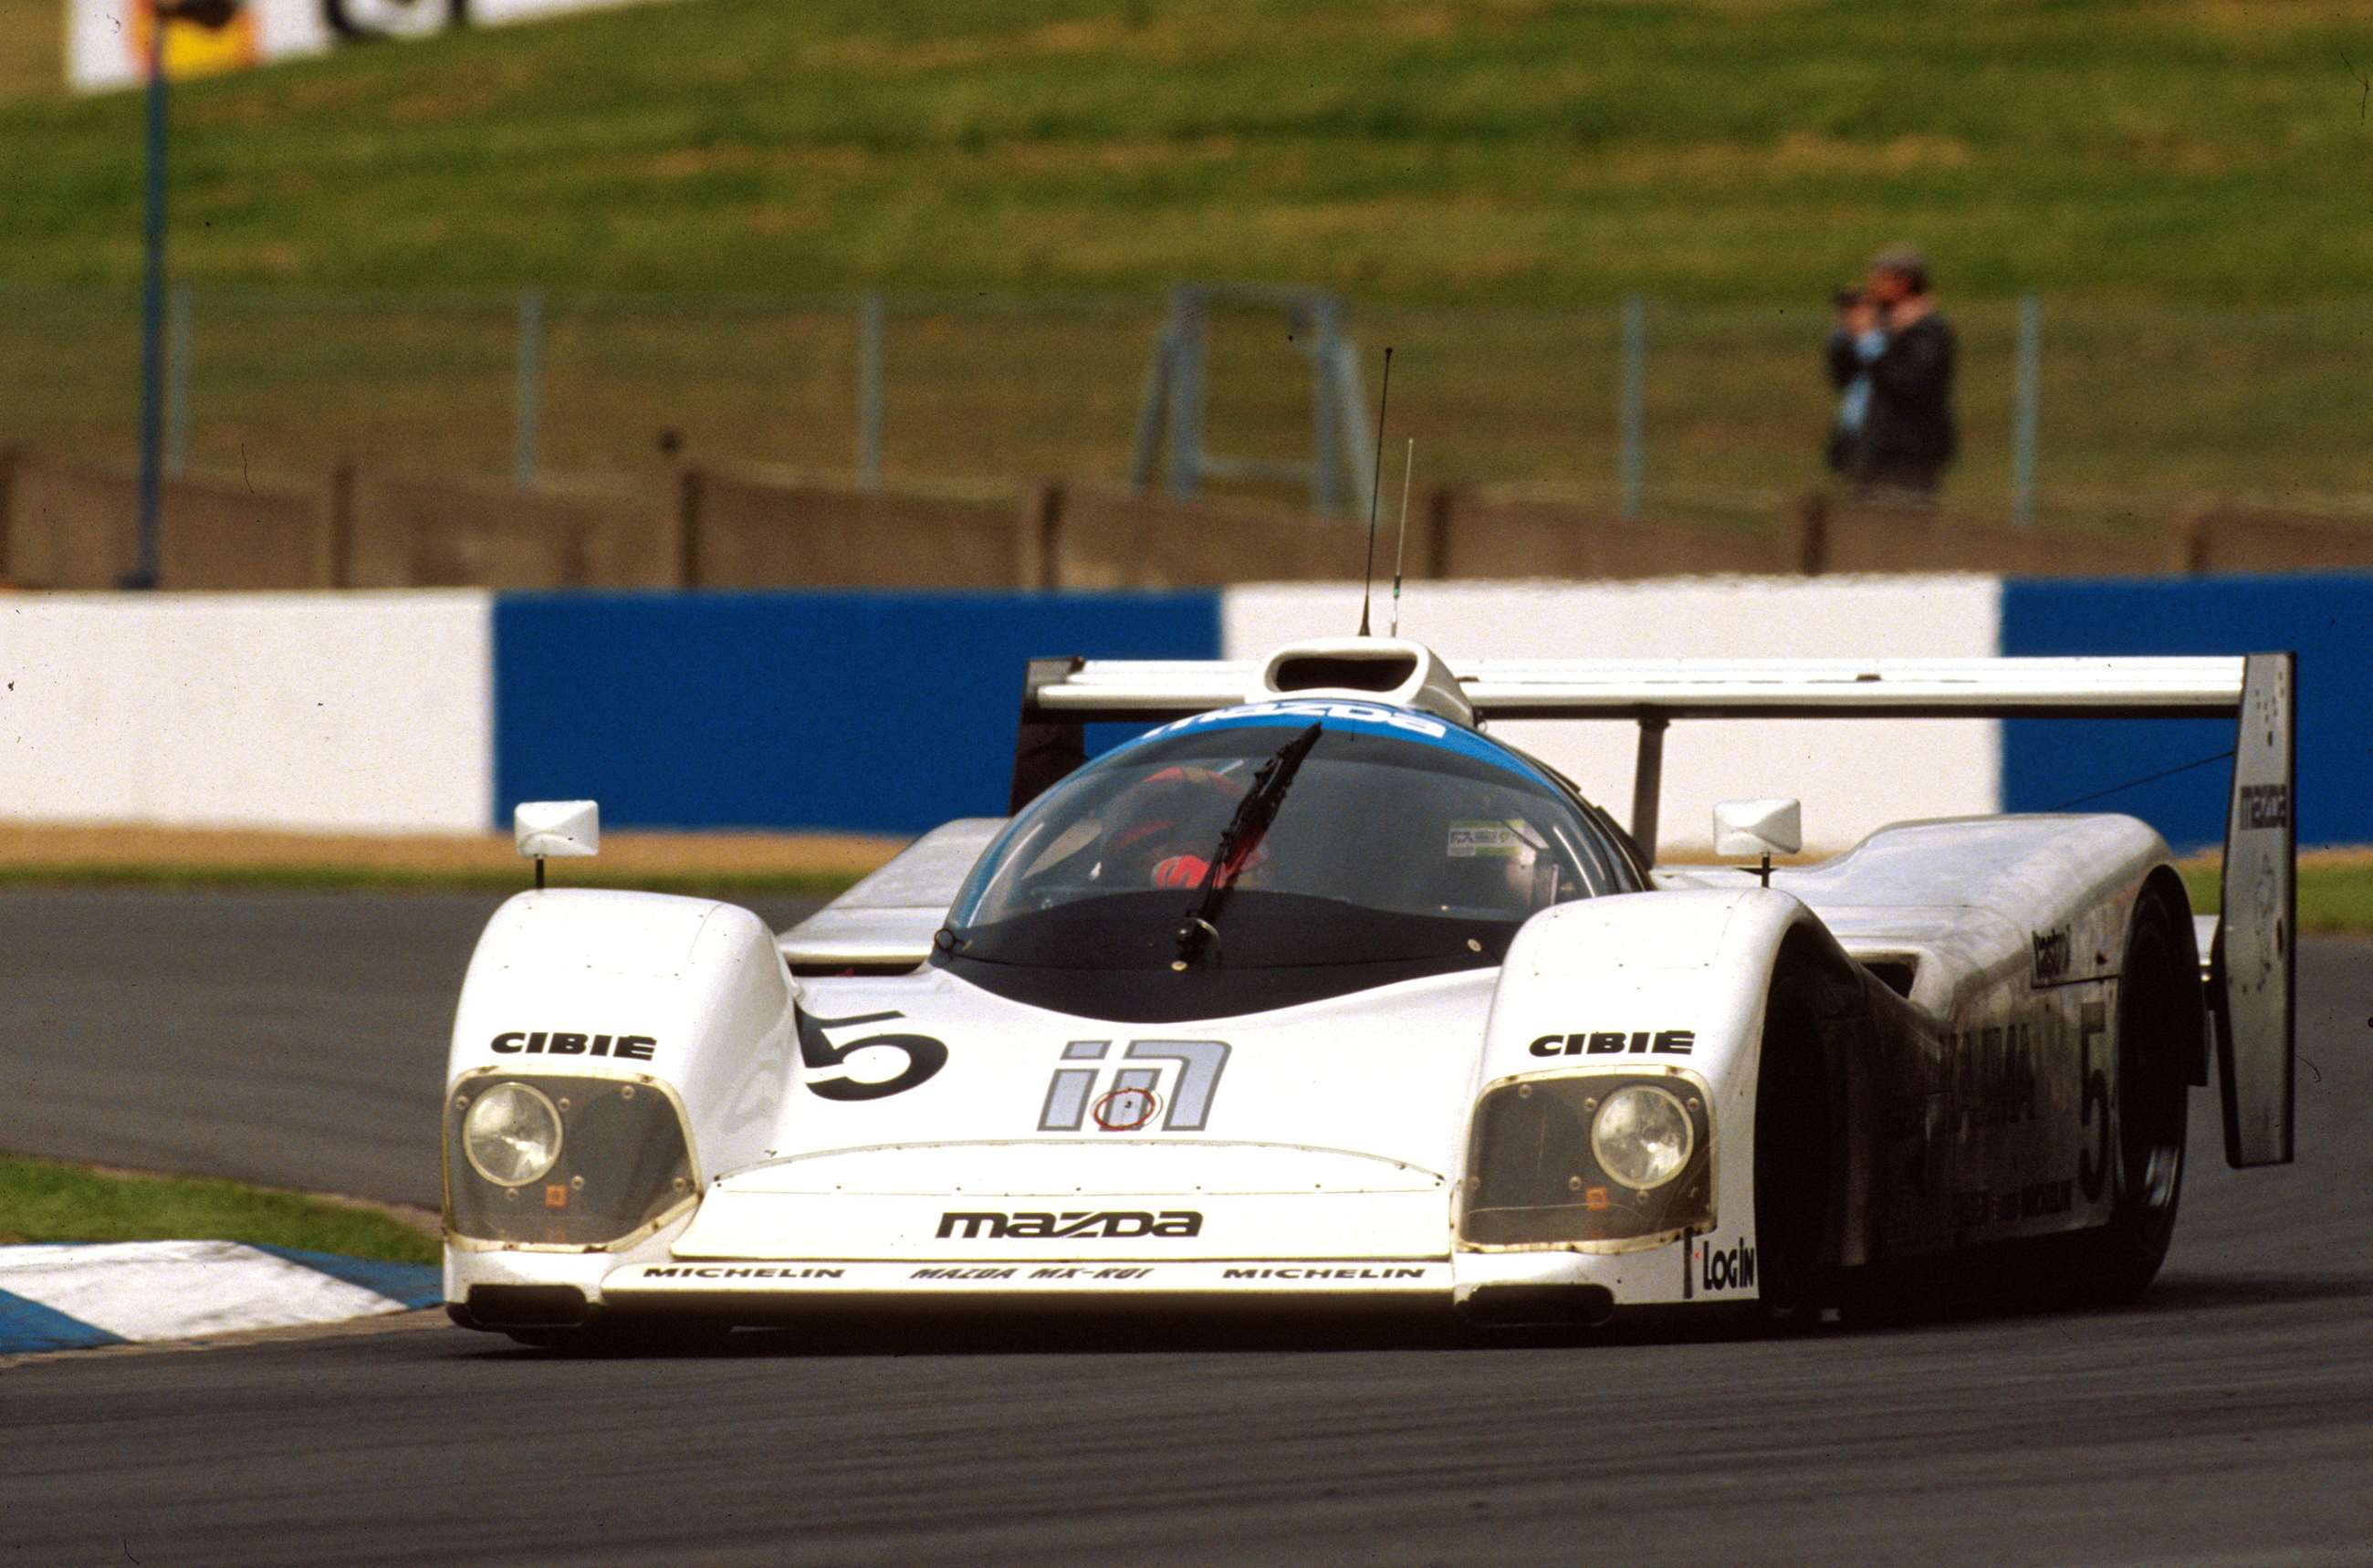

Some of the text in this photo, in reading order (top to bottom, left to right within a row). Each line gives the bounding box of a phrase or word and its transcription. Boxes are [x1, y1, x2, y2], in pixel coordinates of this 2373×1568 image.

[793, 998, 948, 1101] 5
[2080, 1001, 2110, 1205] 5
[643, 1268, 845, 1278] MICHELIN
[911, 1268, 1018, 1279] MAZDA
[1222, 1268, 1426, 1279] MICHELIN
